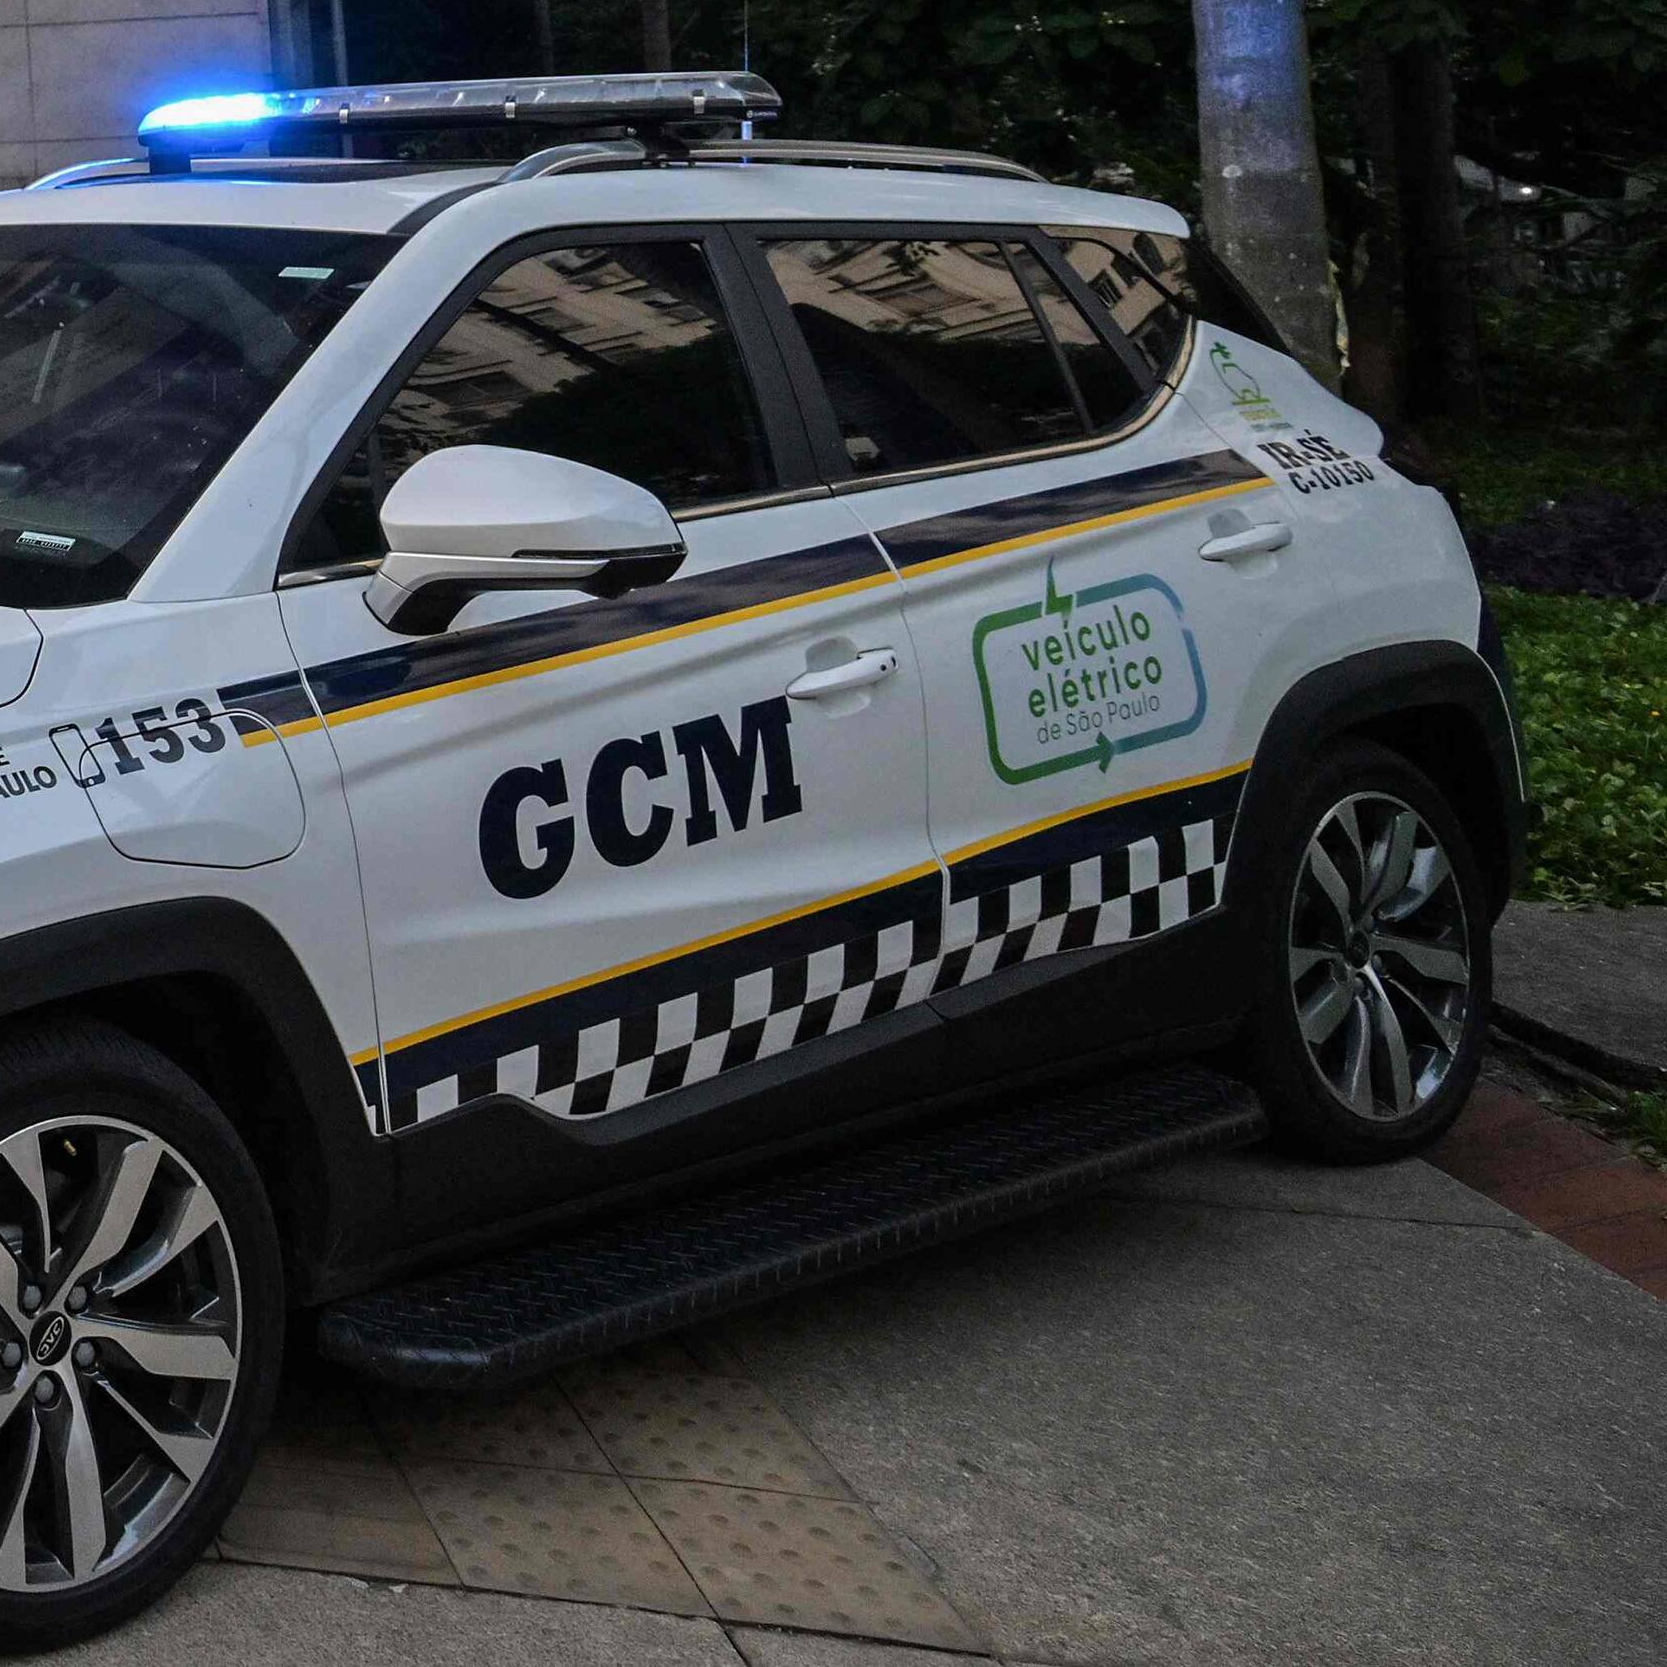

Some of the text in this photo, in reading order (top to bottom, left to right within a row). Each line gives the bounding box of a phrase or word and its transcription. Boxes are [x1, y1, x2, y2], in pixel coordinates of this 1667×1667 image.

[1288, 460, 1375, 495] C-10150
[1028, 656, 1162, 718] elétrico
[95, 698, 227, 775] 153
[1037, 692, 1161, 745] de São Paulo
[479, 695, 803, 900] GCM
